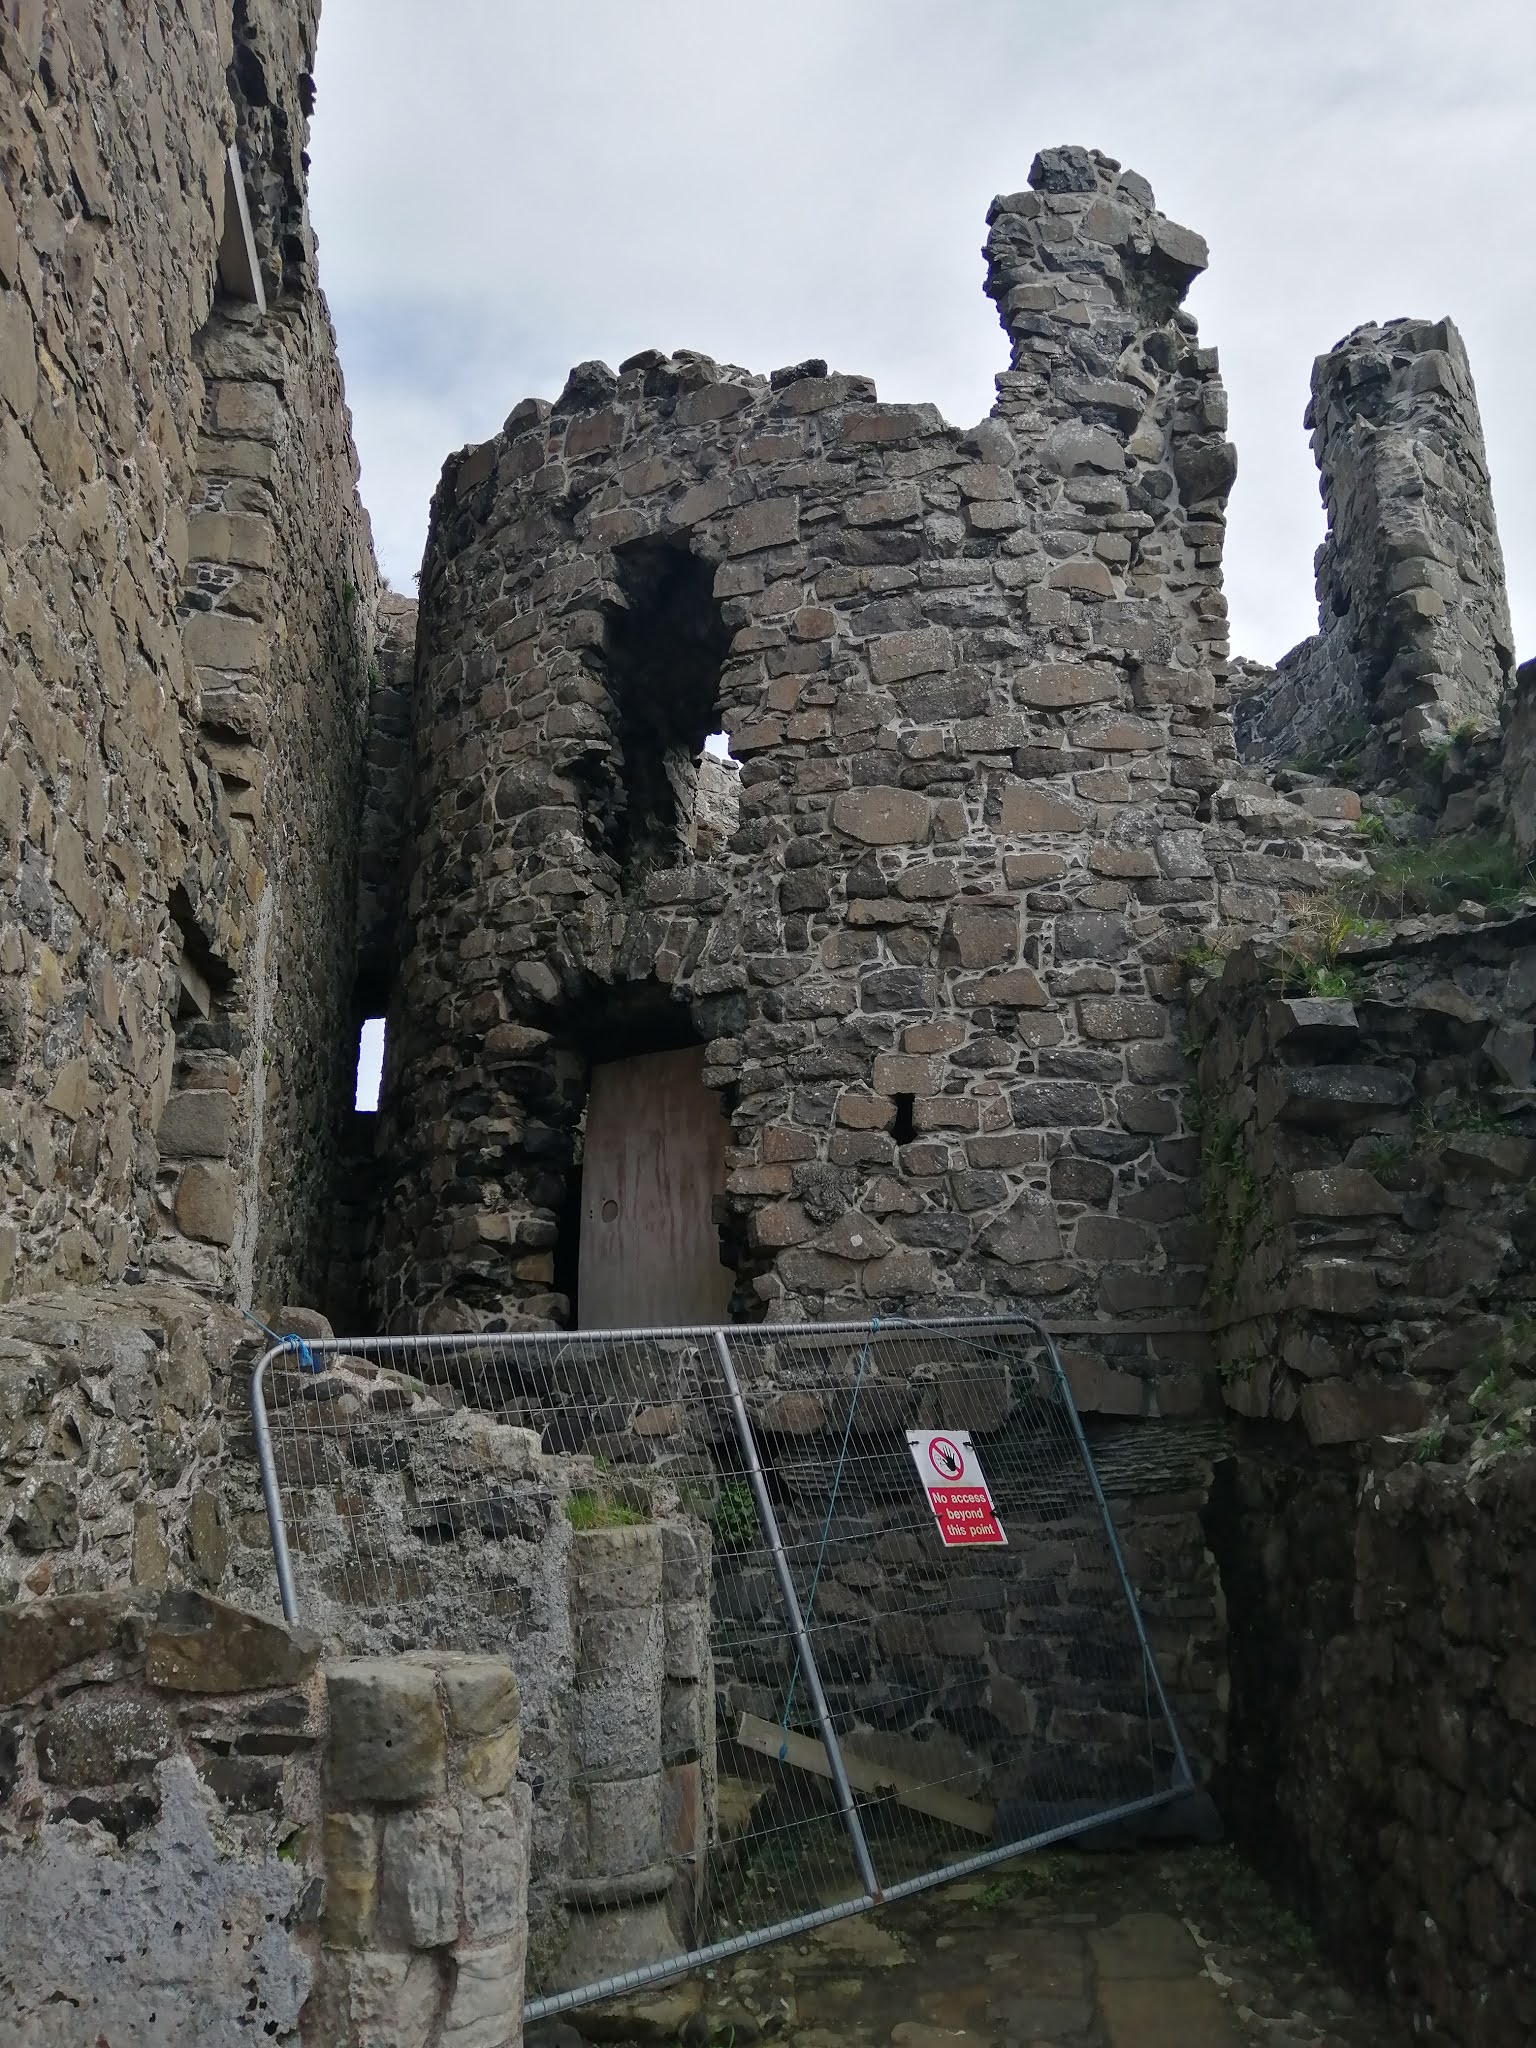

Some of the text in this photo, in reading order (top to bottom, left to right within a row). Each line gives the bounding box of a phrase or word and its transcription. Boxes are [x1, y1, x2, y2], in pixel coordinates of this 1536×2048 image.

[932, 1492, 987, 1504] No access
[946, 1507, 984, 1521] beyond
[947, 1524, 995, 1537] this point
